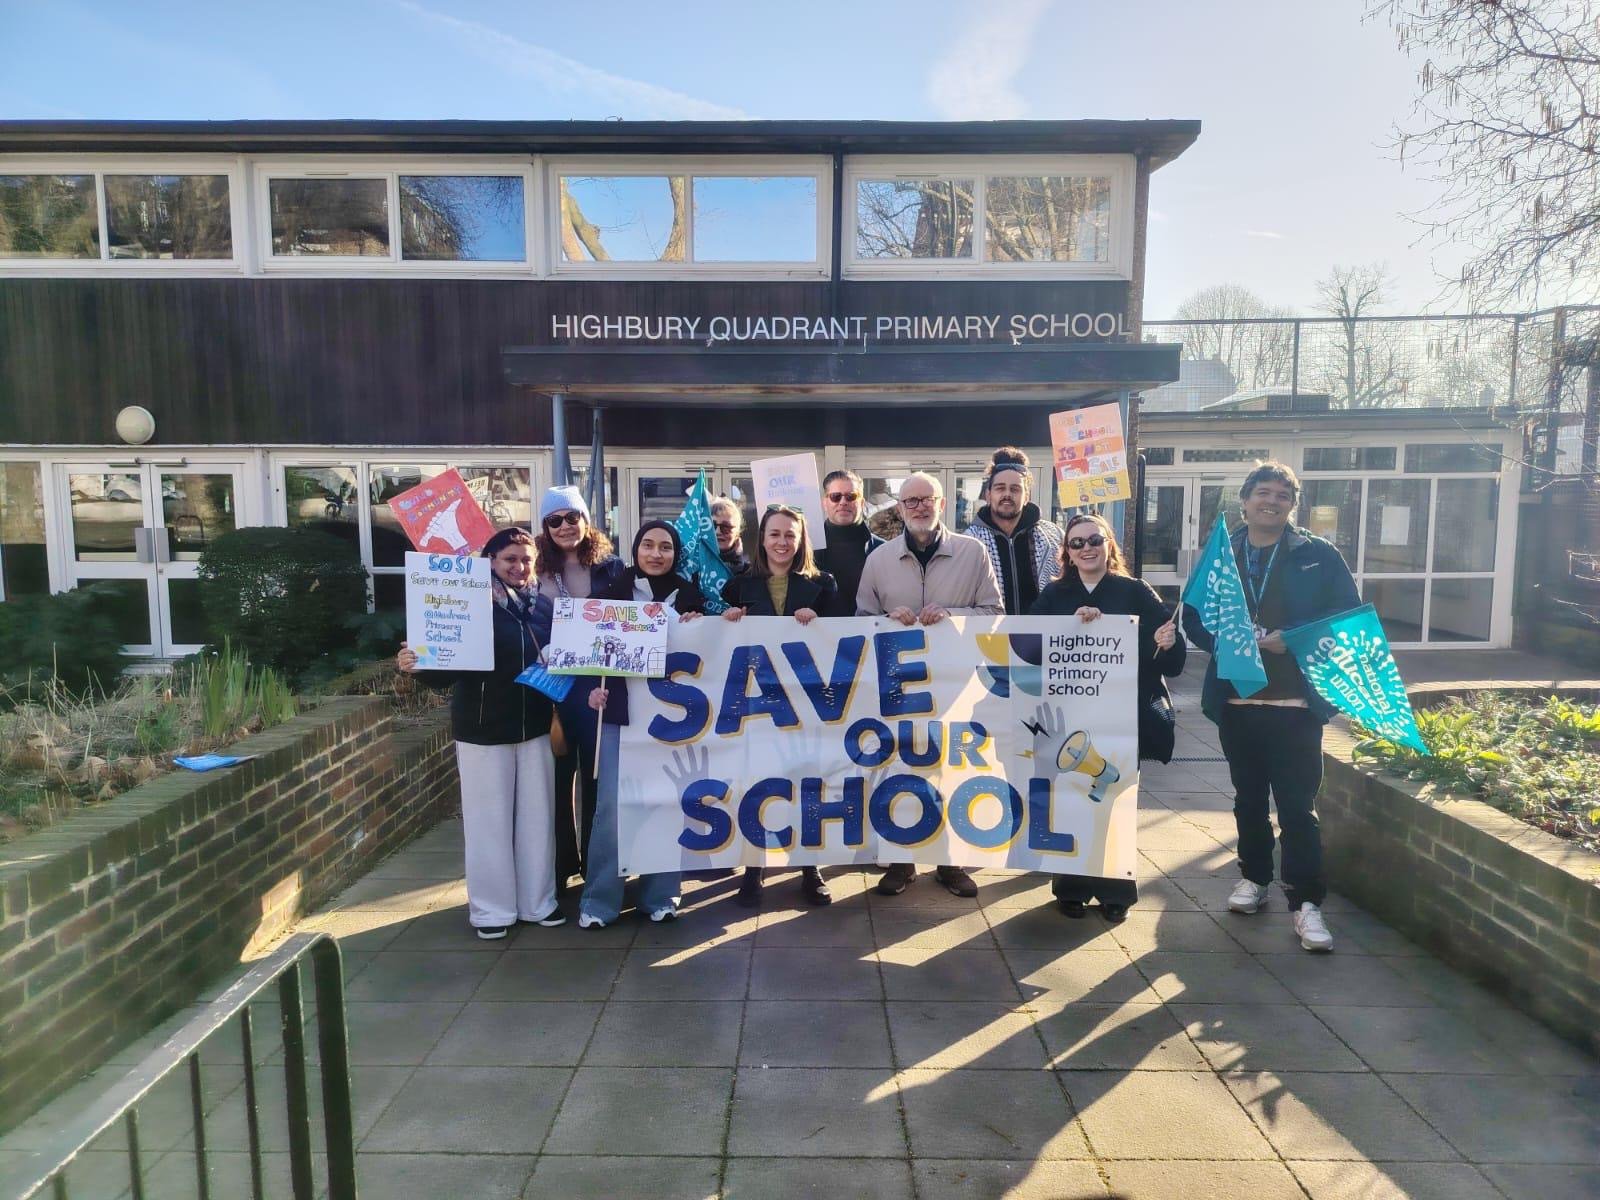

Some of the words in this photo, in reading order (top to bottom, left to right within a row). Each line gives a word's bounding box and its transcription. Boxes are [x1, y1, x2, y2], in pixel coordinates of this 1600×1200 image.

[551, 314, 700, 341] HIGHBURY
[709, 315, 867, 342] QUADRANT
[876, 315, 1001, 340] PRIMARY
[1009, 313, 1132, 340] SCHOOL
[582, 599, 639, 622] SAVE
[1048, 634, 1122, 652] Highbury
[1048, 651, 1126, 665] Quadrant
[647, 628, 936, 745] SAVE
[1048, 666, 1108, 684] Primary
[1358, 653, 1397, 716] national
[1047, 683, 1100, 697] School
[1329, 673, 1367, 712] union
[843, 716, 994, 772] OUR
[677, 773, 1079, 857] SCHOOL
